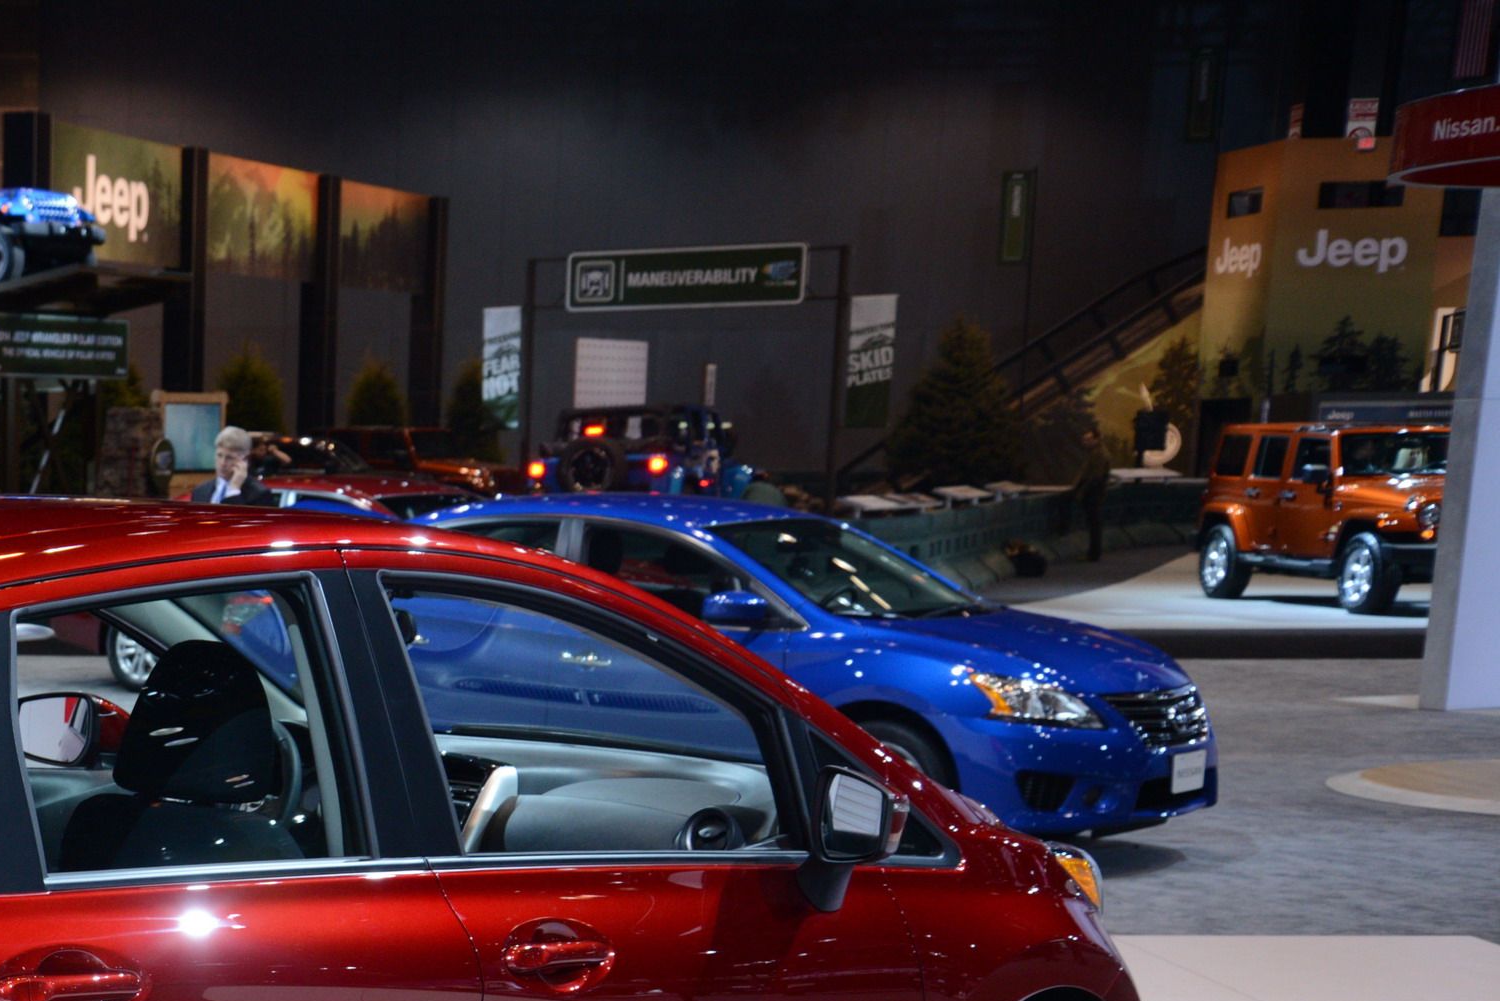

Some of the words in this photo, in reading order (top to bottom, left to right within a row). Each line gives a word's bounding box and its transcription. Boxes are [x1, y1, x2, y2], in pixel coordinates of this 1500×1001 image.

[73, 153, 150, 242] Jeep
[1215, 237, 1263, 278] Jeep
[1297, 228, 1408, 273] Jeep
[627, 267, 758, 288] MANEUVERABILITY
[483, 353, 520, 378] FEAR
[848, 346, 895, 373] SKID
